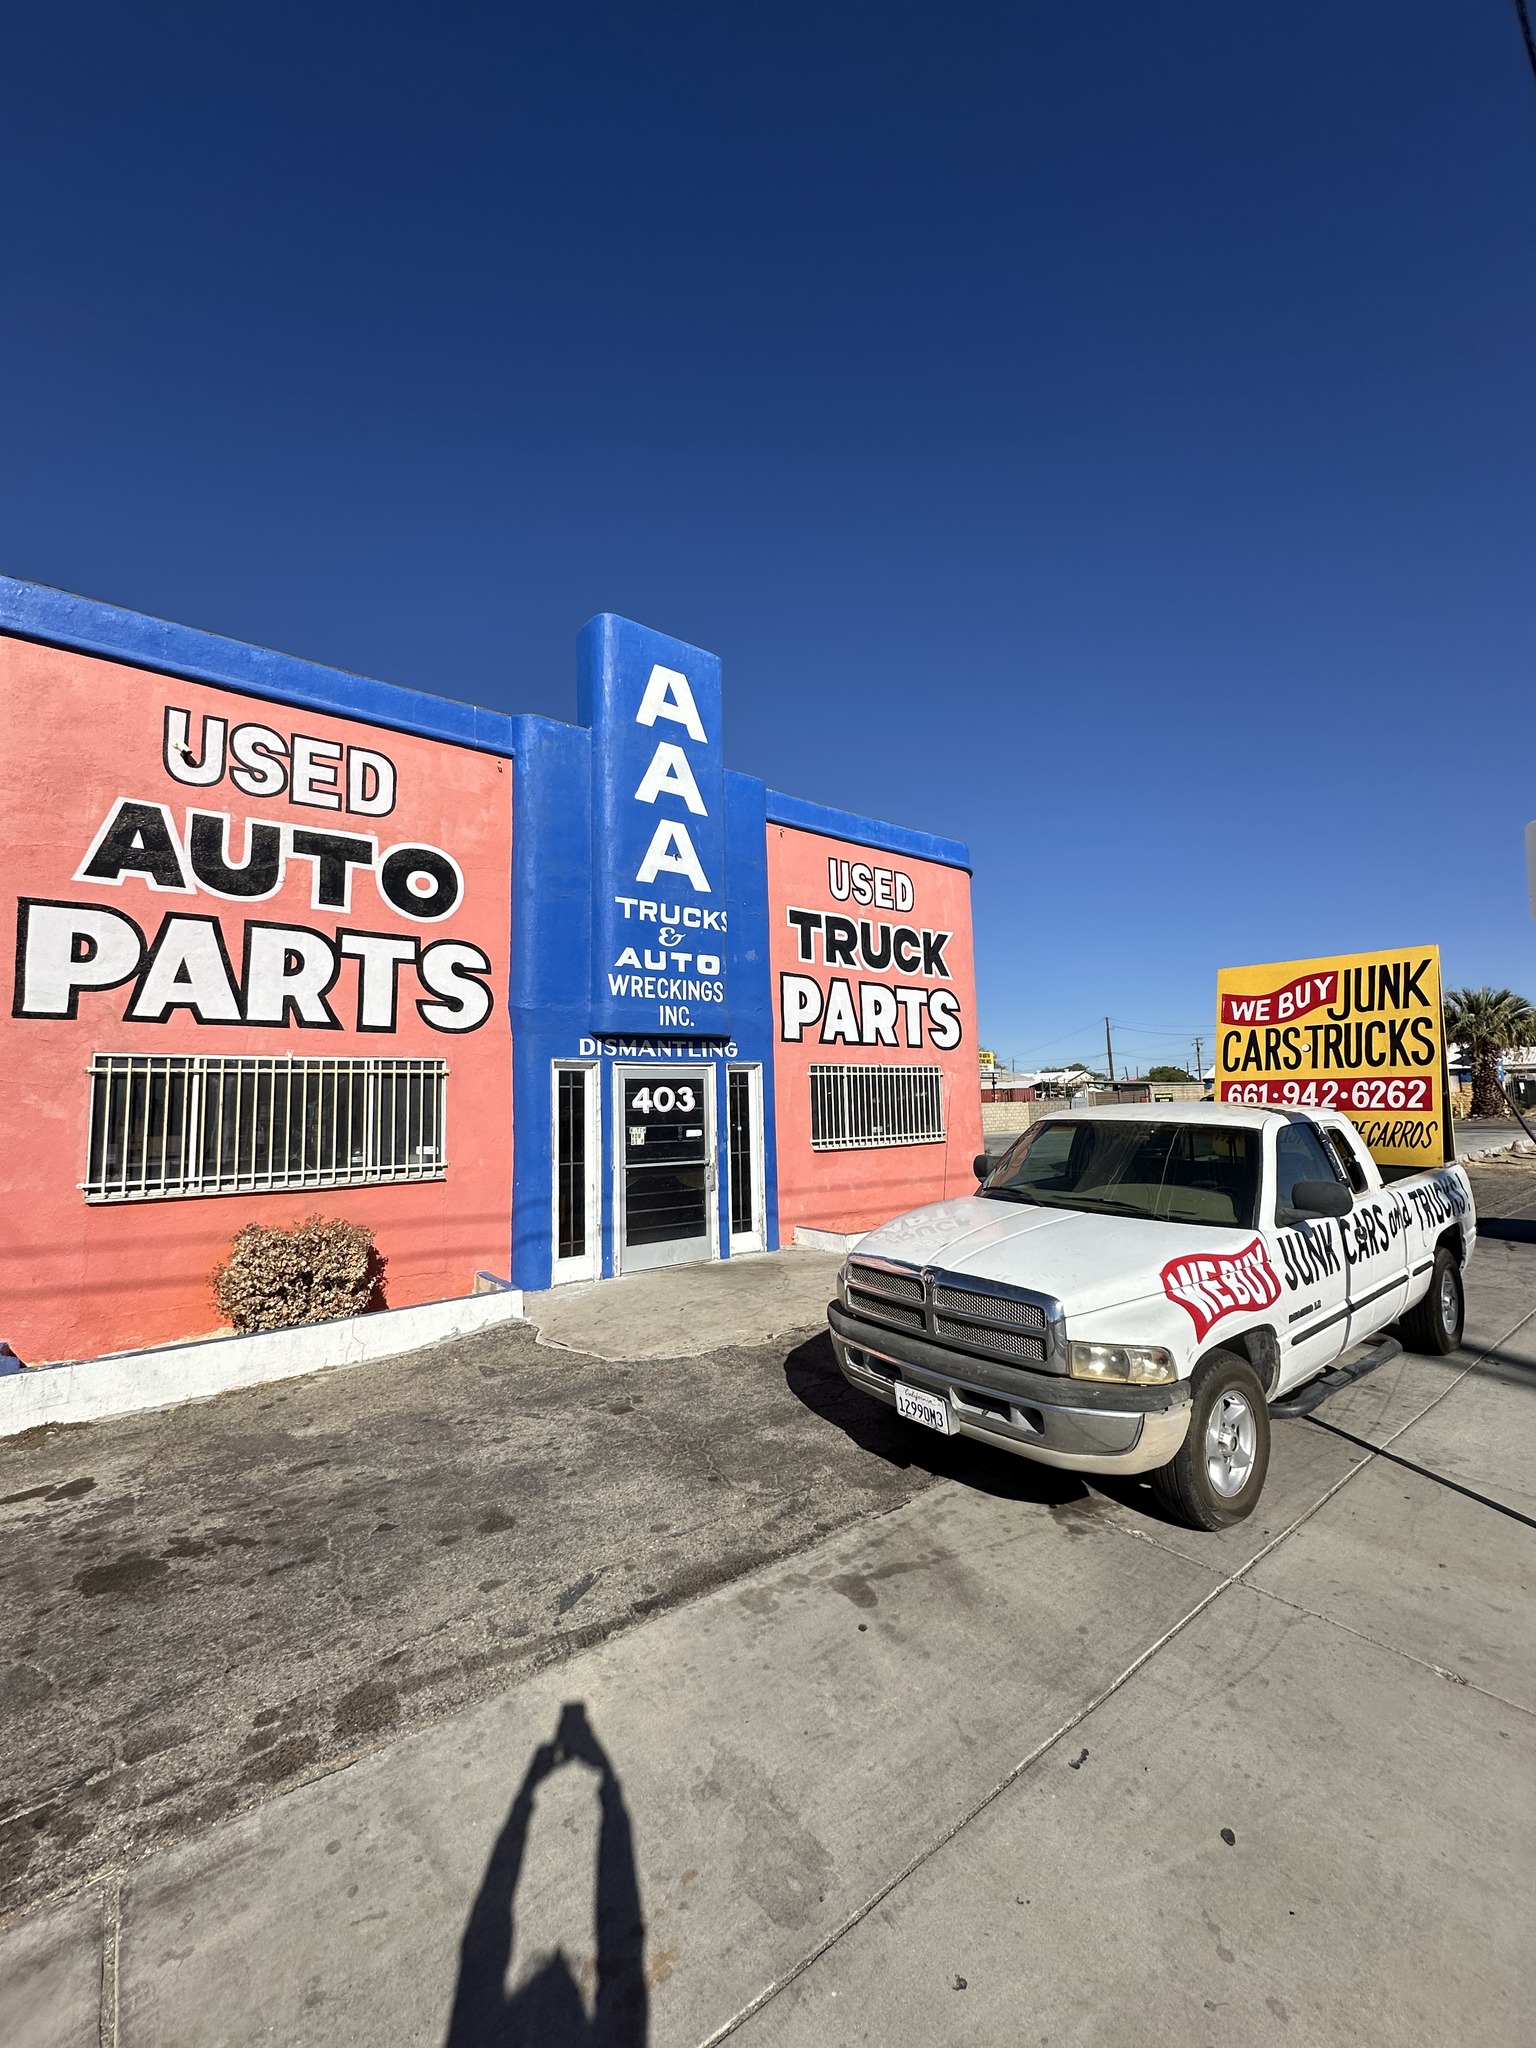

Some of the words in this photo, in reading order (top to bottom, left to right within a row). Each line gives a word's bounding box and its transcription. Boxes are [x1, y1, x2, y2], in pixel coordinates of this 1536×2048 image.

[164, 705, 397, 818] USED
[71, 796, 465, 924] AUTO
[827, 857, 915, 913] USED
[614, 946, 721, 976] AUTO
[658, 926, 687, 947] &
[786, 905, 954, 981] TRUCK
[12, 897, 494, 1034] PARTS
[607, 973, 724, 1003] WRECKINGS
[1230, 998, 1272, 1021] WE
[1278, 975, 1334, 1019] BUY
[1326, 958, 1433, 1021] JUNK
[659, 1004, 695, 1027] INC.
[780, 972, 963, 1050] PARTS
[579, 1037, 739, 1058] DISMANTLING
[1222, 1026, 1302, 1073] CARS
[1304, 1016, 1436, 1069] TRUCKS
[631, 1086, 696, 1114] 403
[1367, 1120, 1439, 1149] CARROS
[1166, 1260, 1236, 1324] WE
[1218, 1243, 1277, 1305] BUY
[1276, 1217, 1341, 1291] JUNK
[1340, 1204, 1390, 1265] CARS
[1388, 1190, 1413, 1238] and
